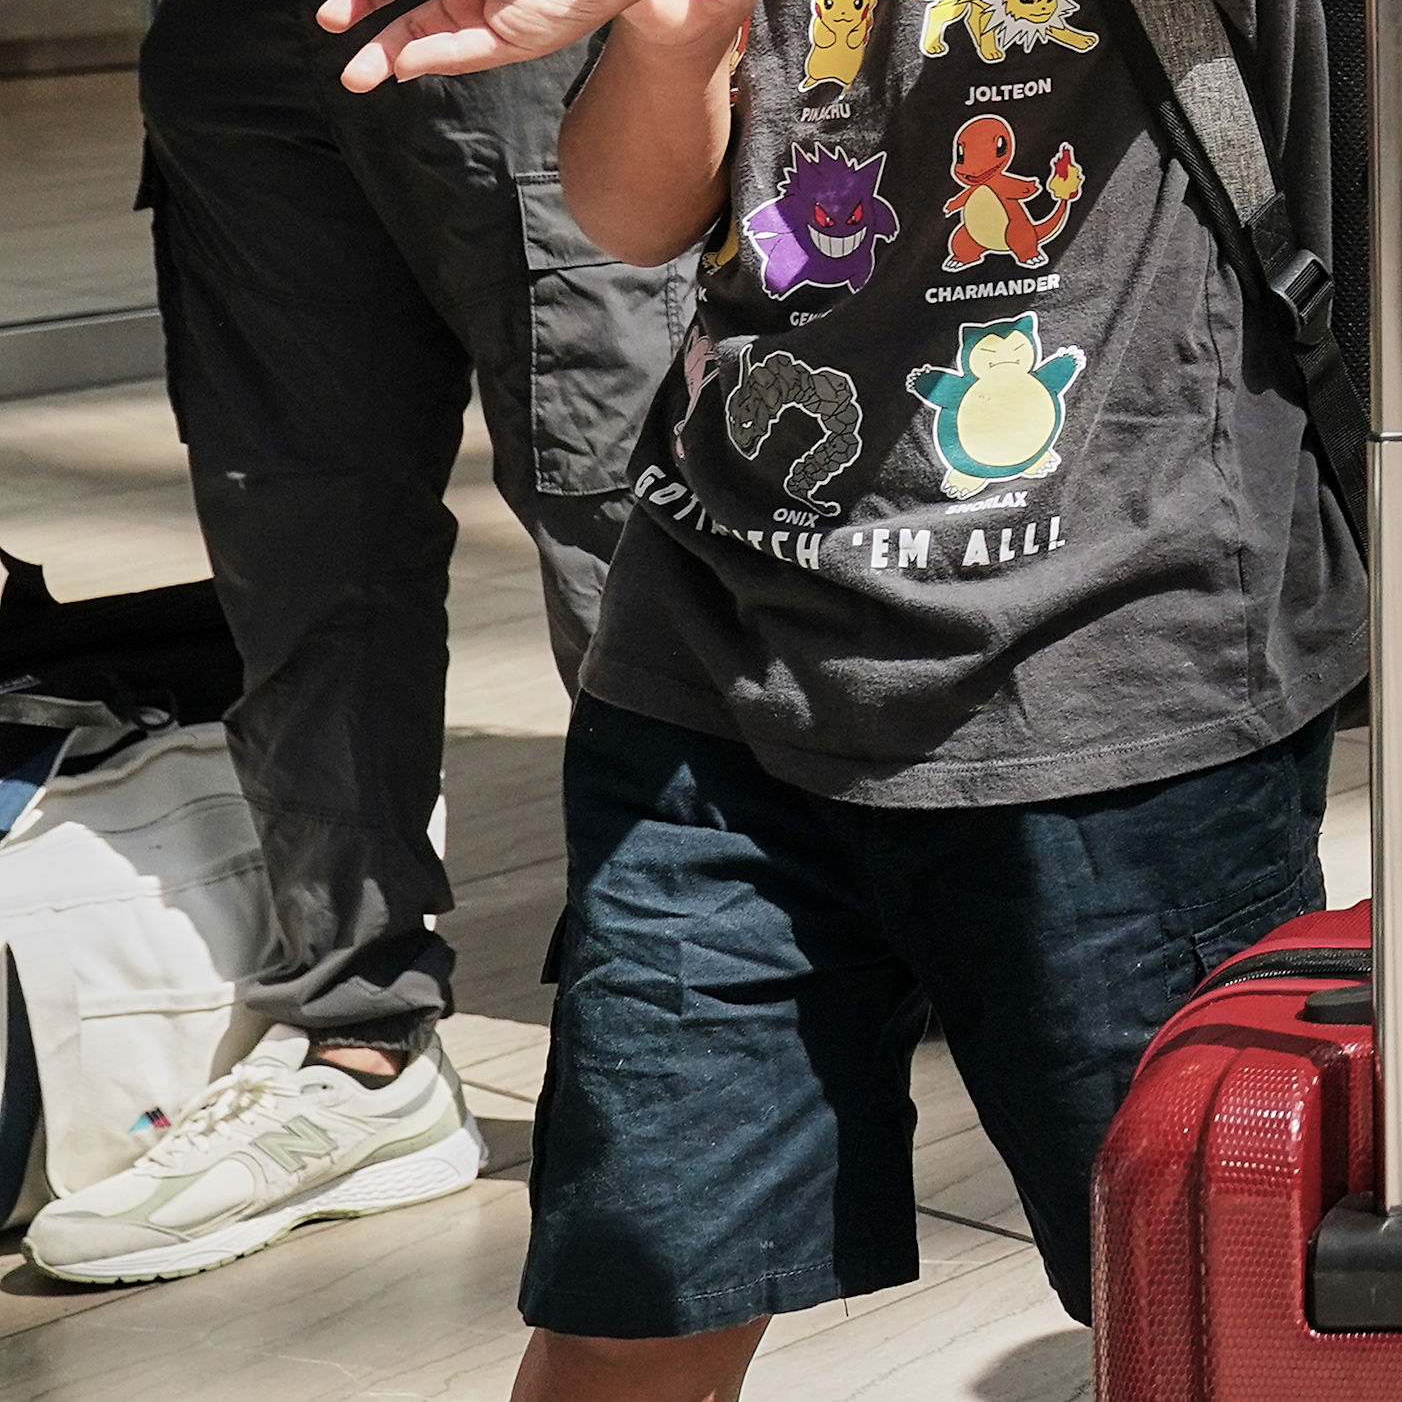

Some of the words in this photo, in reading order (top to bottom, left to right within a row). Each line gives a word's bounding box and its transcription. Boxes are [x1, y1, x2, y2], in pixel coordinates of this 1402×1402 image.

[964, 77, 1052, 106] JOLTEON
[800, 102, 851, 123] PIKACHU
[924, 273, 1061, 304] CHARMANDER
[772, 507, 821, 529] ONIX
